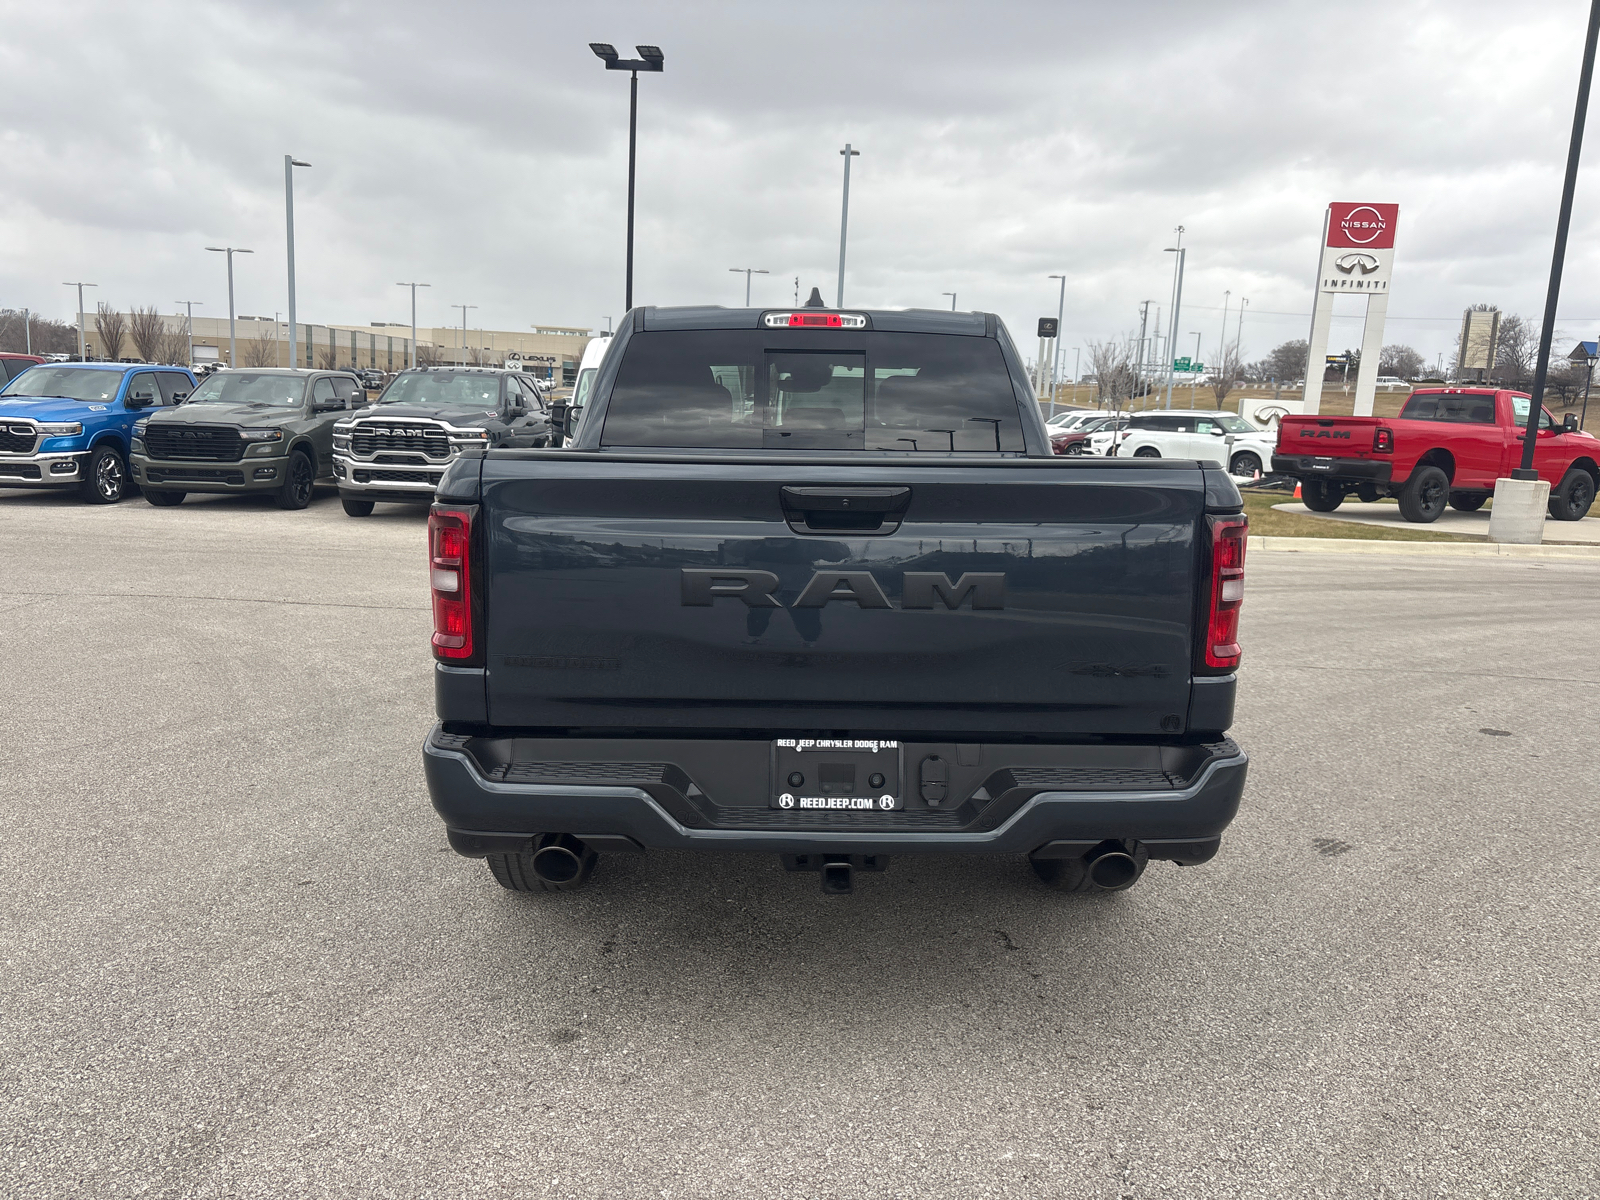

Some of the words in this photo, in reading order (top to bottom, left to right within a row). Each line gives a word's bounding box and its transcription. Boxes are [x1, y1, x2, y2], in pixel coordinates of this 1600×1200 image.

[1341, 221, 1386, 229] NISSAN
[1324, 279, 1387, 289] INFINITI
[167, 431, 213, 439] RAM
[375, 428, 422, 437] RAM
[1300, 429, 1351, 439] RAM
[681, 567, 1006, 611] RAM
[777, 739, 796, 747] REED
[798, 739, 815, 748] JEEP
[816, 740, 853, 748] CHRYSLER
[854, 740, 879, 748] DODGE
[880, 741, 898, 749] RAM
[800, 797, 873, 809] REEDJEEP.COM
